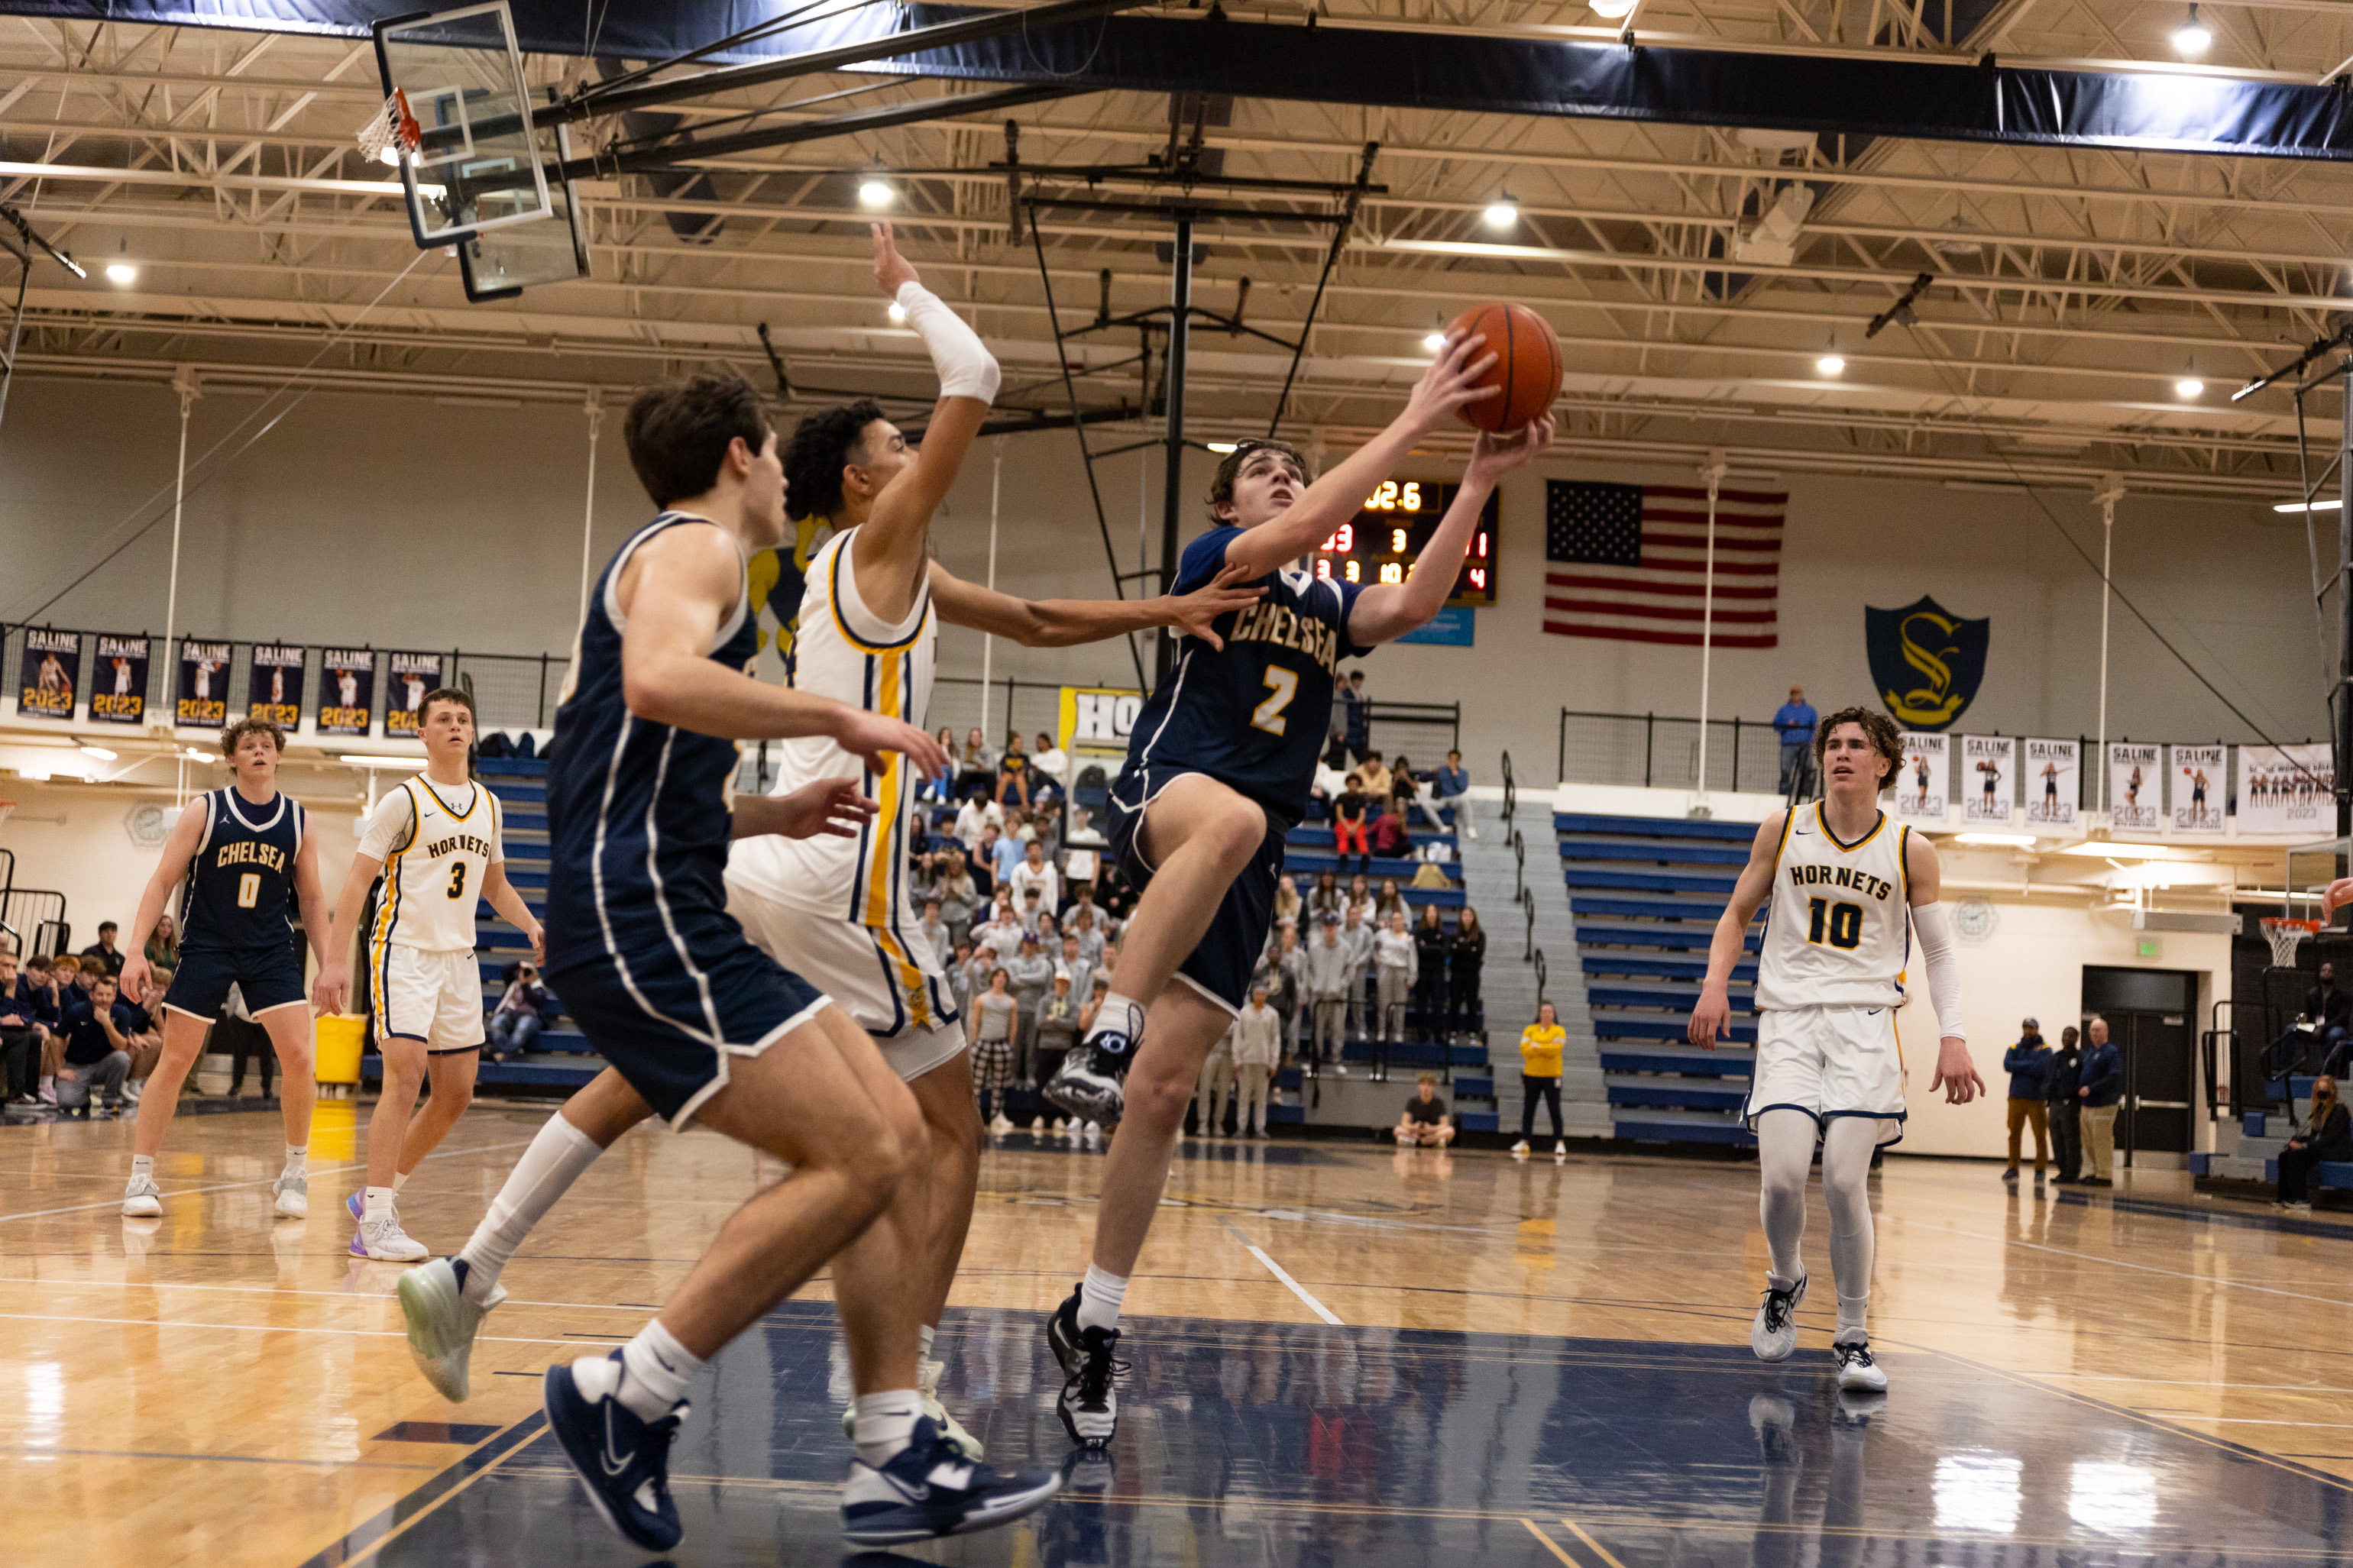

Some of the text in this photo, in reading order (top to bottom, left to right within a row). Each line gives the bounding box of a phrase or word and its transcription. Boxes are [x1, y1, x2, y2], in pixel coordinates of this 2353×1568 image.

[1392, 528, 1407, 553] 3
[1316, 558, 1332, 580] 3
[1345, 560, 1361, 584] 3
[1380, 562, 1403, 584] 10
[1469, 568, 1486, 590] 4
[28, 629, 79, 648] SALINE
[99, 636, 149, 654] SALINE
[1231, 603, 1336, 677] CHELSEA
[183, 642, 231, 660] SALINE
[254, 646, 304, 664] SALINE
[325, 649, 374, 667] SALINE
[391, 653, 440, 670] SALINE
[23, 687, 73, 711] 2023
[93, 693, 142, 716] 2023
[177, 698, 225, 719] 2023
[1250, 664, 1299, 737] 2
[251, 703, 299, 723] 2023
[320, 706, 369, 728] 2023
[387, 710, 419, 729] 202
[1967, 739, 2011, 754] SALINE
[2030, 742, 2075, 757] SALINE
[2113, 746, 2157, 761] SALINE
[2175, 748, 2222, 763] SALINE
[1900, 794, 1943, 811] 2023
[1966, 798, 2009, 815] 2023
[2030, 801, 2073, 819] 2023
[2113, 805, 2157, 821] 2023
[2177, 807, 2221, 823] 2023
[2287, 808, 2317, 820] 2023
[427, 833, 490, 859] HORNETS
[217, 841, 286, 875] CHELSEA
[446, 861, 468, 900] 3
[1789, 864, 1892, 902] HORNETS
[237, 873, 261, 909] 0
[1807, 896, 1864, 952] 10
